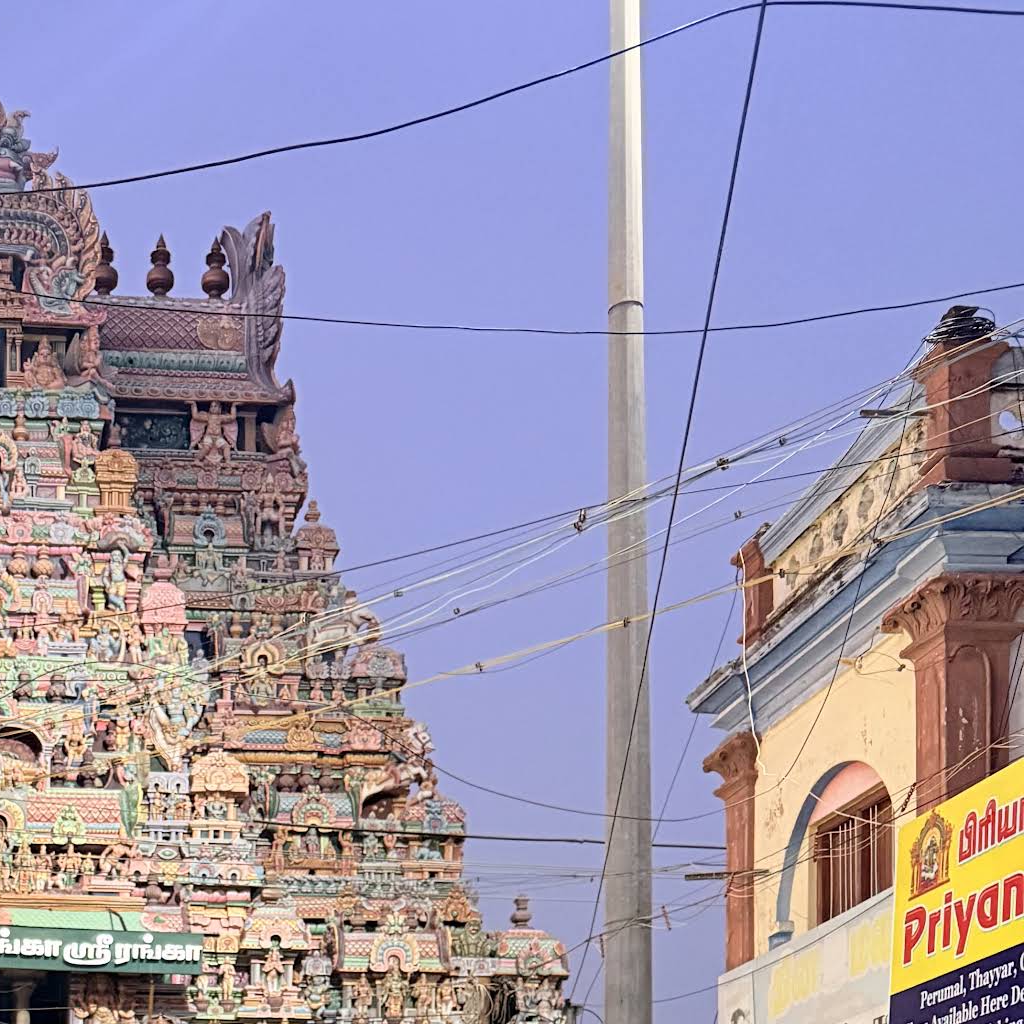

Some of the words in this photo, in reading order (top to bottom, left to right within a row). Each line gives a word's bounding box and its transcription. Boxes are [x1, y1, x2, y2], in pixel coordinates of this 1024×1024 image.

[920, 975, 966, 1010] Perumal,
[969, 961, 1017, 991] Thayyar,
[980, 994, 1009, 1016] Here
